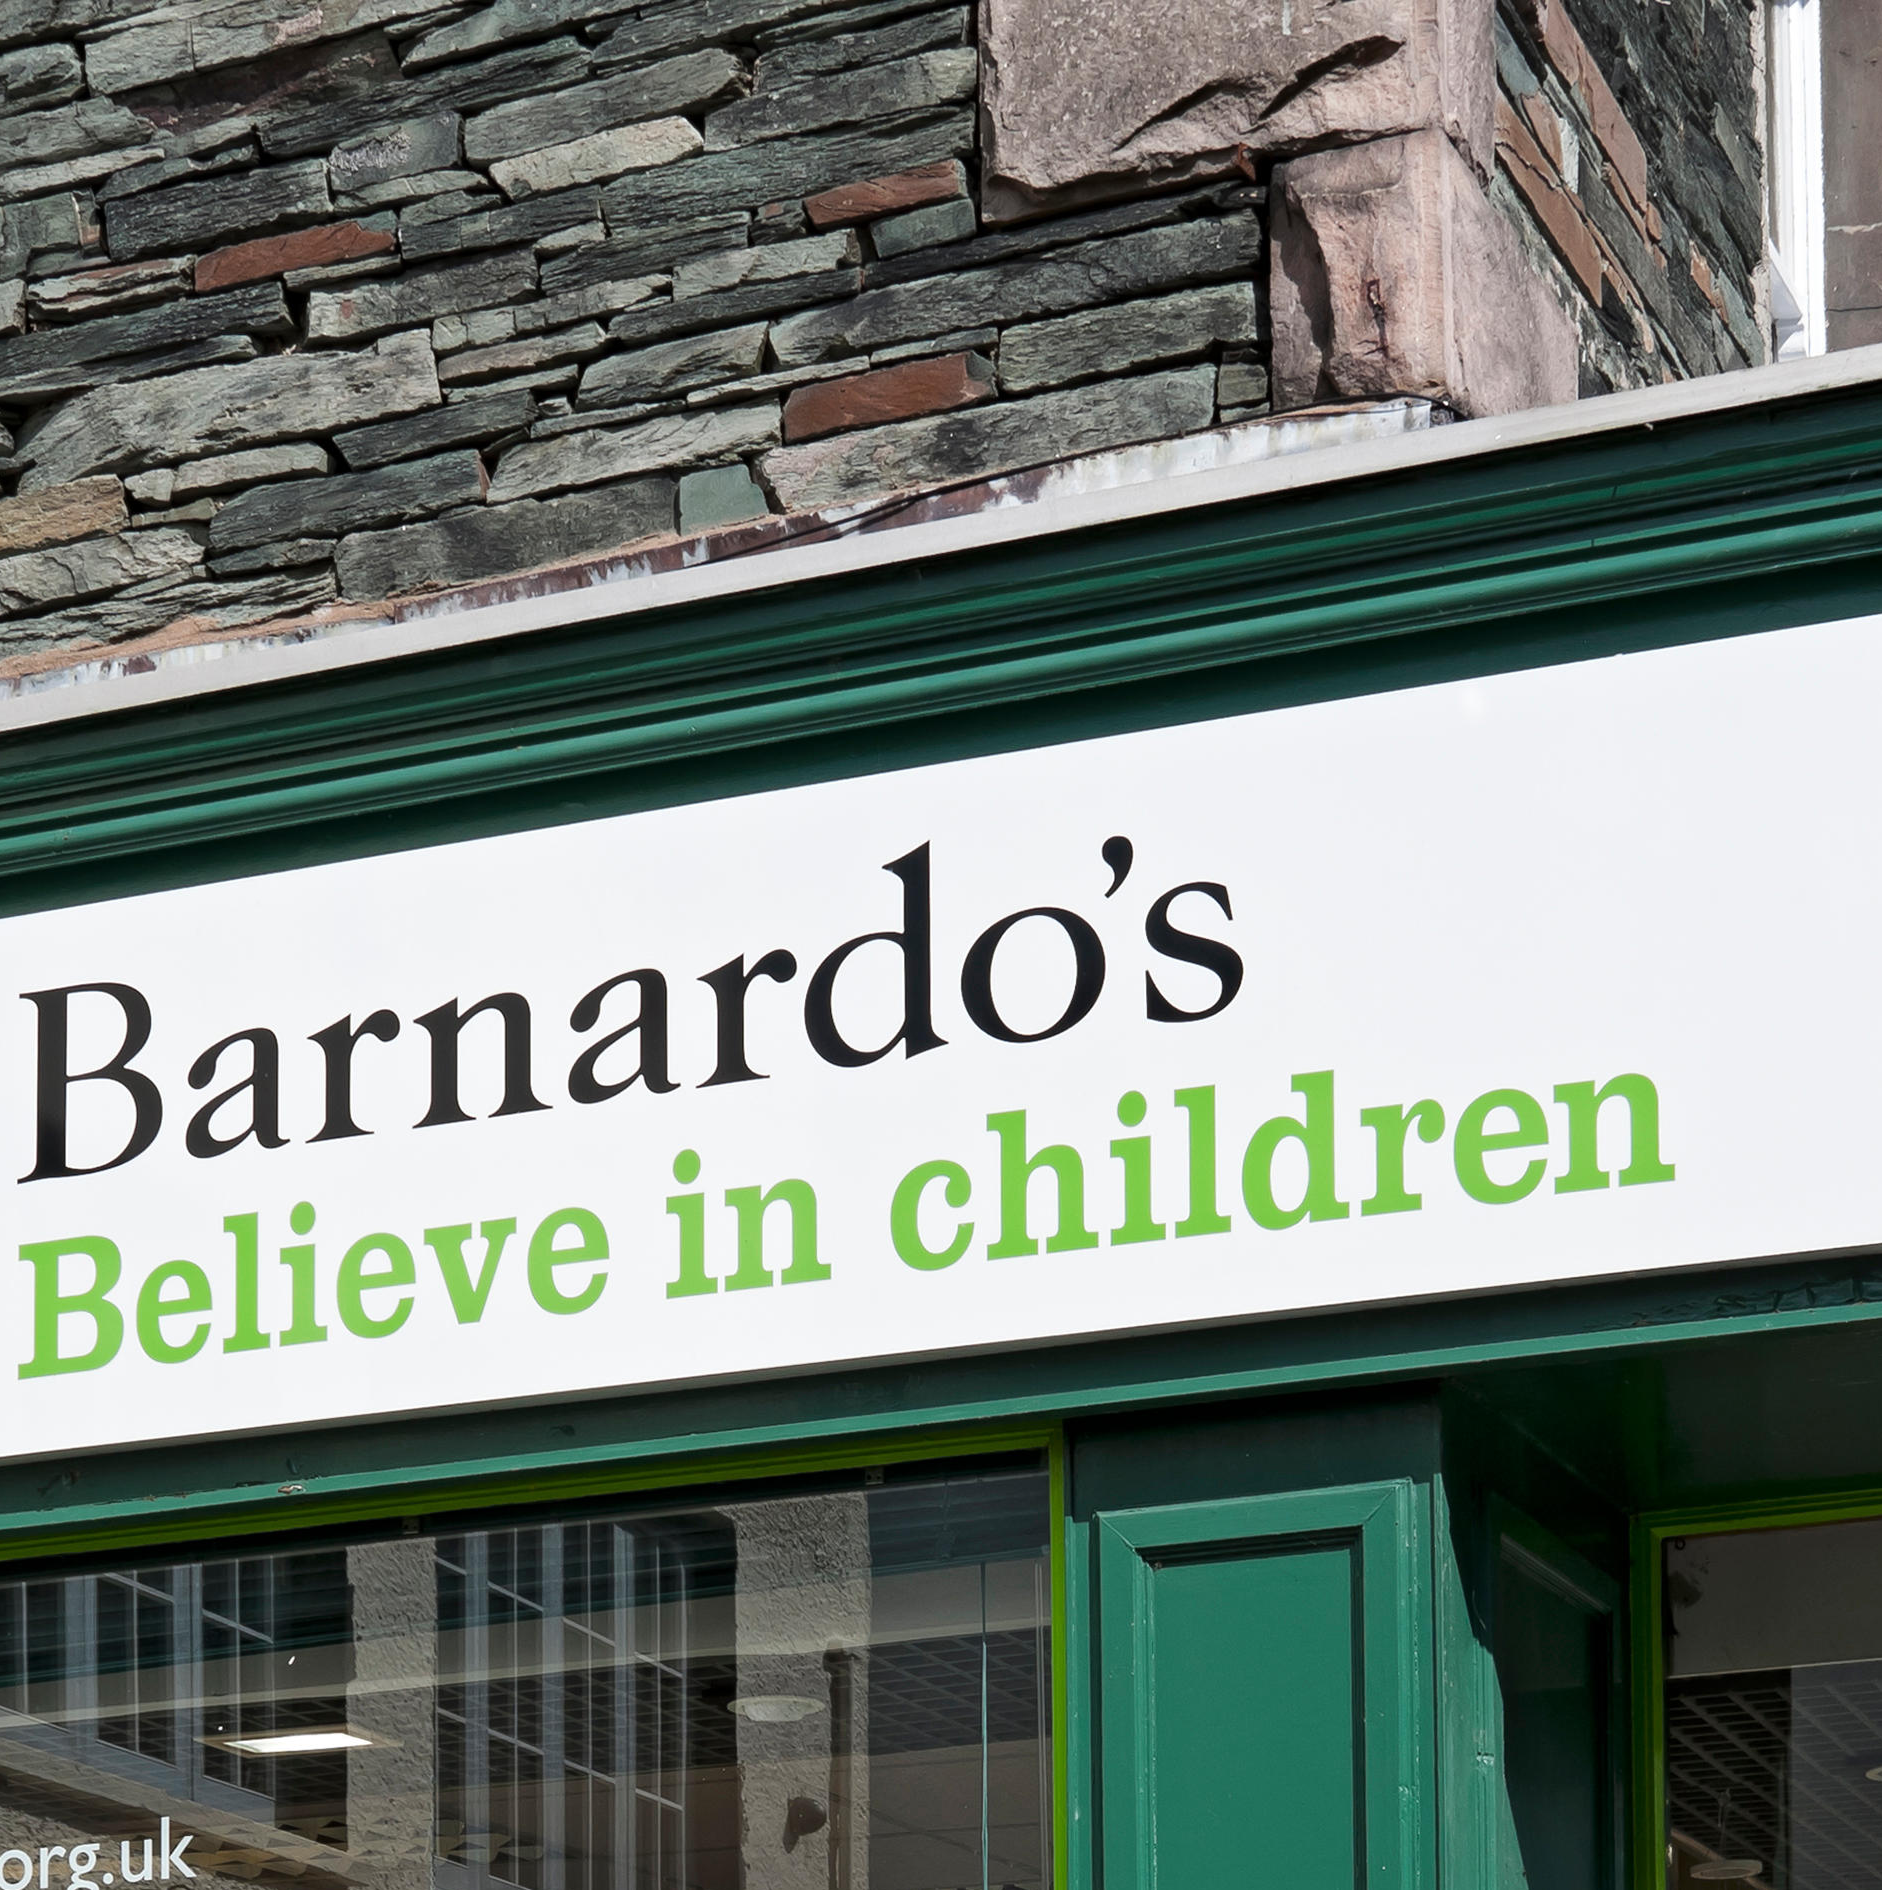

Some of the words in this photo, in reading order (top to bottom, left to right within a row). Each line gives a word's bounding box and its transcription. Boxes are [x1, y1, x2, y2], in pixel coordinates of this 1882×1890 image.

[17, 836, 1244, 1184] Barnardo's
[17, 1200, 610, 1380] Believe
[665, 1148, 832, 1299] in
[889, 1068, 1677, 1272] children
